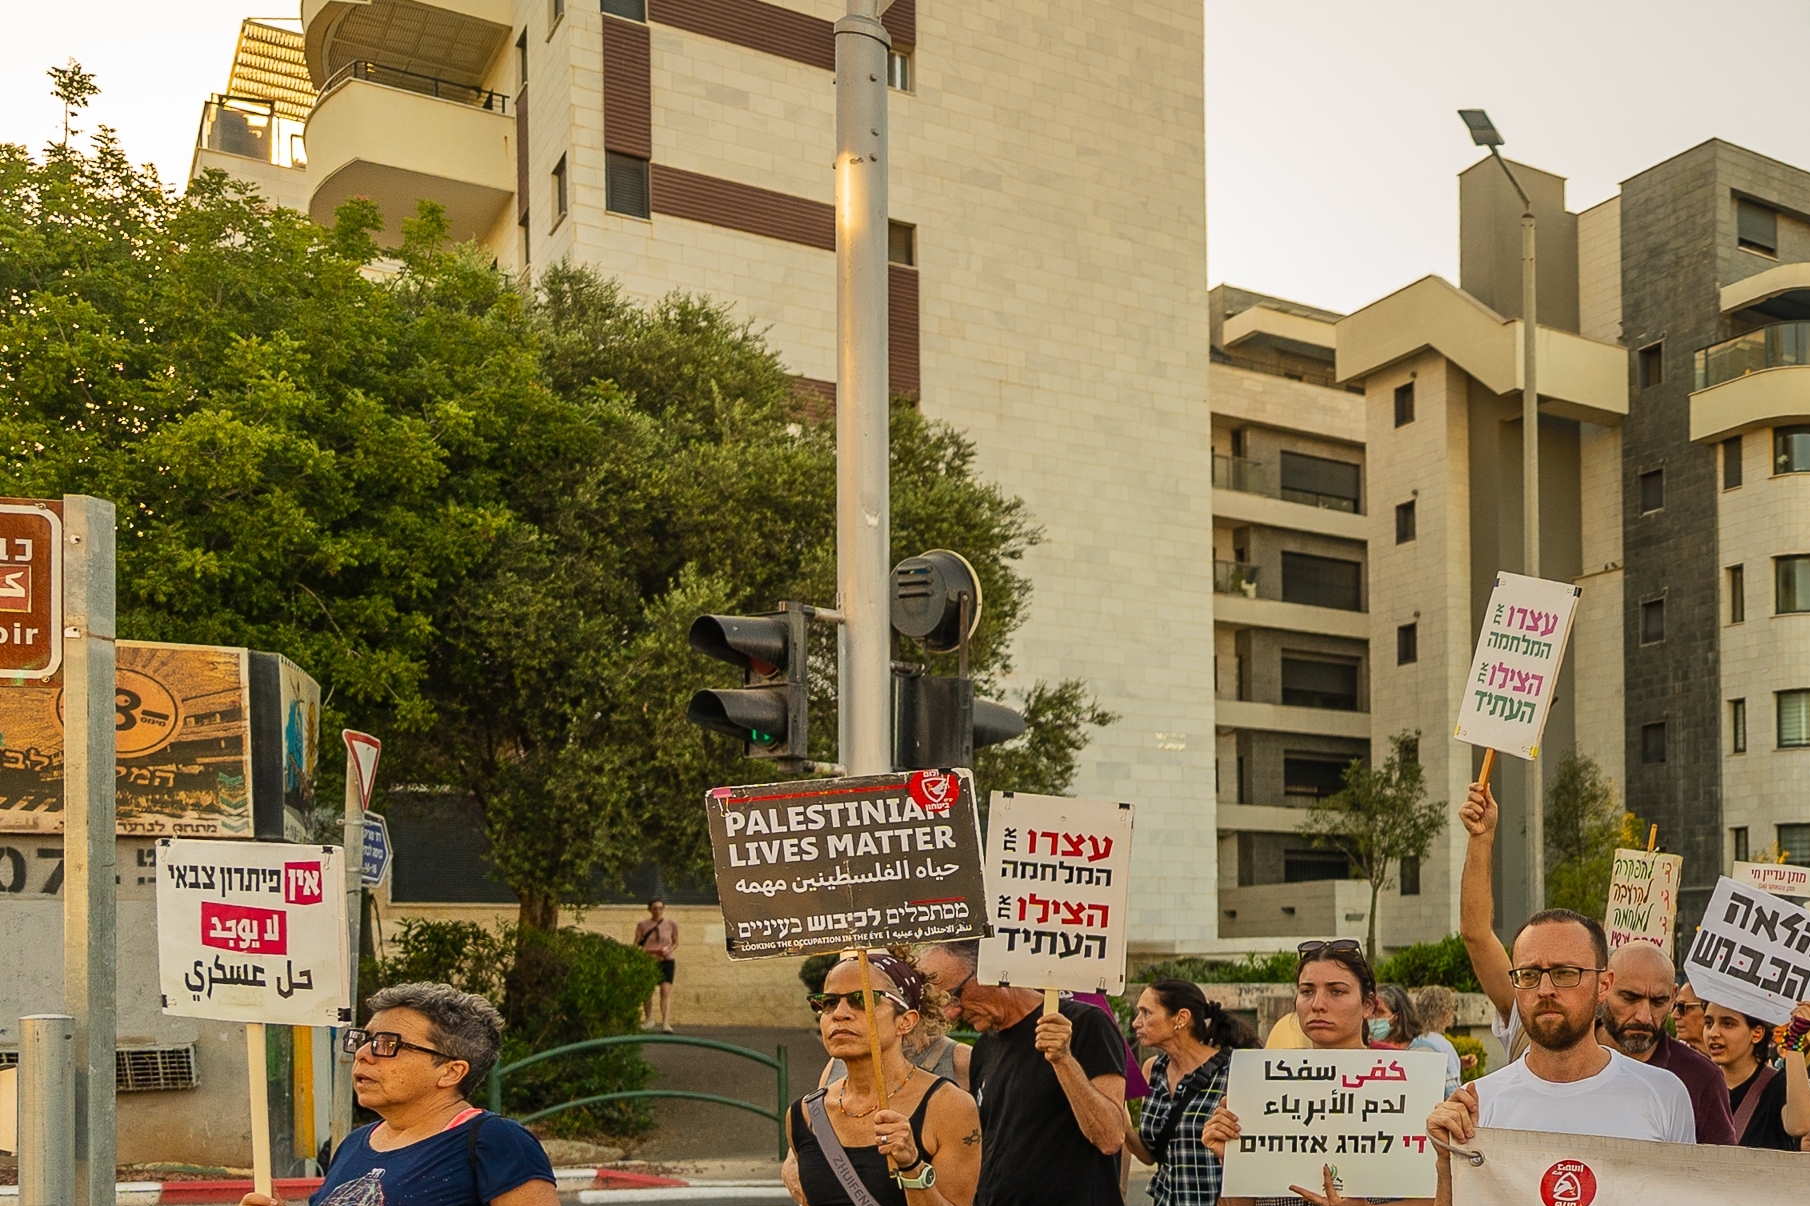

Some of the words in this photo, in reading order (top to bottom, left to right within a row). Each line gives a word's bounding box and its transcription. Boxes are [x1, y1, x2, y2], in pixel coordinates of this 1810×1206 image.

[1493, 603, 1505, 625] את
[1506, 605, 1559, 637] עצרו
[1487, 631, 1552, 660] המלחמה
[1477, 661, 1489, 684] את
[1488, 661, 1544, 697] הצילו
[1474, 690, 1536, 724] העתיד
[728, 836, 819, 867] LIVES
[827, 825, 956, 859] MATTER
[1003, 827, 1017, 852] את
[1027, 829, 1113, 862] עצרו
[167, 864, 215, 889] צבאי
[220, 867, 282, 897] פיתרון
[916, 858, 960, 882] حياه
[1001, 859, 1112, 887] המלחמה
[1661, 862, 1672, 884] די
[1751, 868, 1760, 879] חי
[1762, 869, 1786, 881] עדיין
[1787, 871, 1807, 884] מתן
[287, 868, 320, 901] אין
[735, 876, 786, 897] مهمه
[887, 900, 969, 925] מסתכלים
[997, 894, 1011, 919] את
[1017, 893, 1109, 928] הצילו
[1660, 889, 1670, 911] די
[264, 914, 279, 941] لا
[737, 917, 803, 939] בעיניים
[807, 908, 883, 934] לכיבוש
[1613, 903, 1655, 932] למלחמה
[1659, 916, 1668, 935] די
[209, 916, 260, 948] يوجد
[741, 941, 776, 952] LOOKING
[776, 940, 793, 949] THE
[793, 935, 841, 947] OCCUPATION
[853, 933, 868, 941] THE
[998, 927, 1107, 959] העתיד
[185, 954, 266, 1002] عسكري
[276, 960, 313, 999] حل
[1265, 1059, 1336, 1081] سفكا
[1342, 1059, 1407, 1088] كفى
[1263, 1089, 1355, 1126] الأبرياء
[1361, 1094, 1406, 1122] لدم
[1240, 1134, 1328, 1154] אזרחים
[1335, 1131, 1394, 1154] להרג
[1402, 1135, 1427, 1154] די
